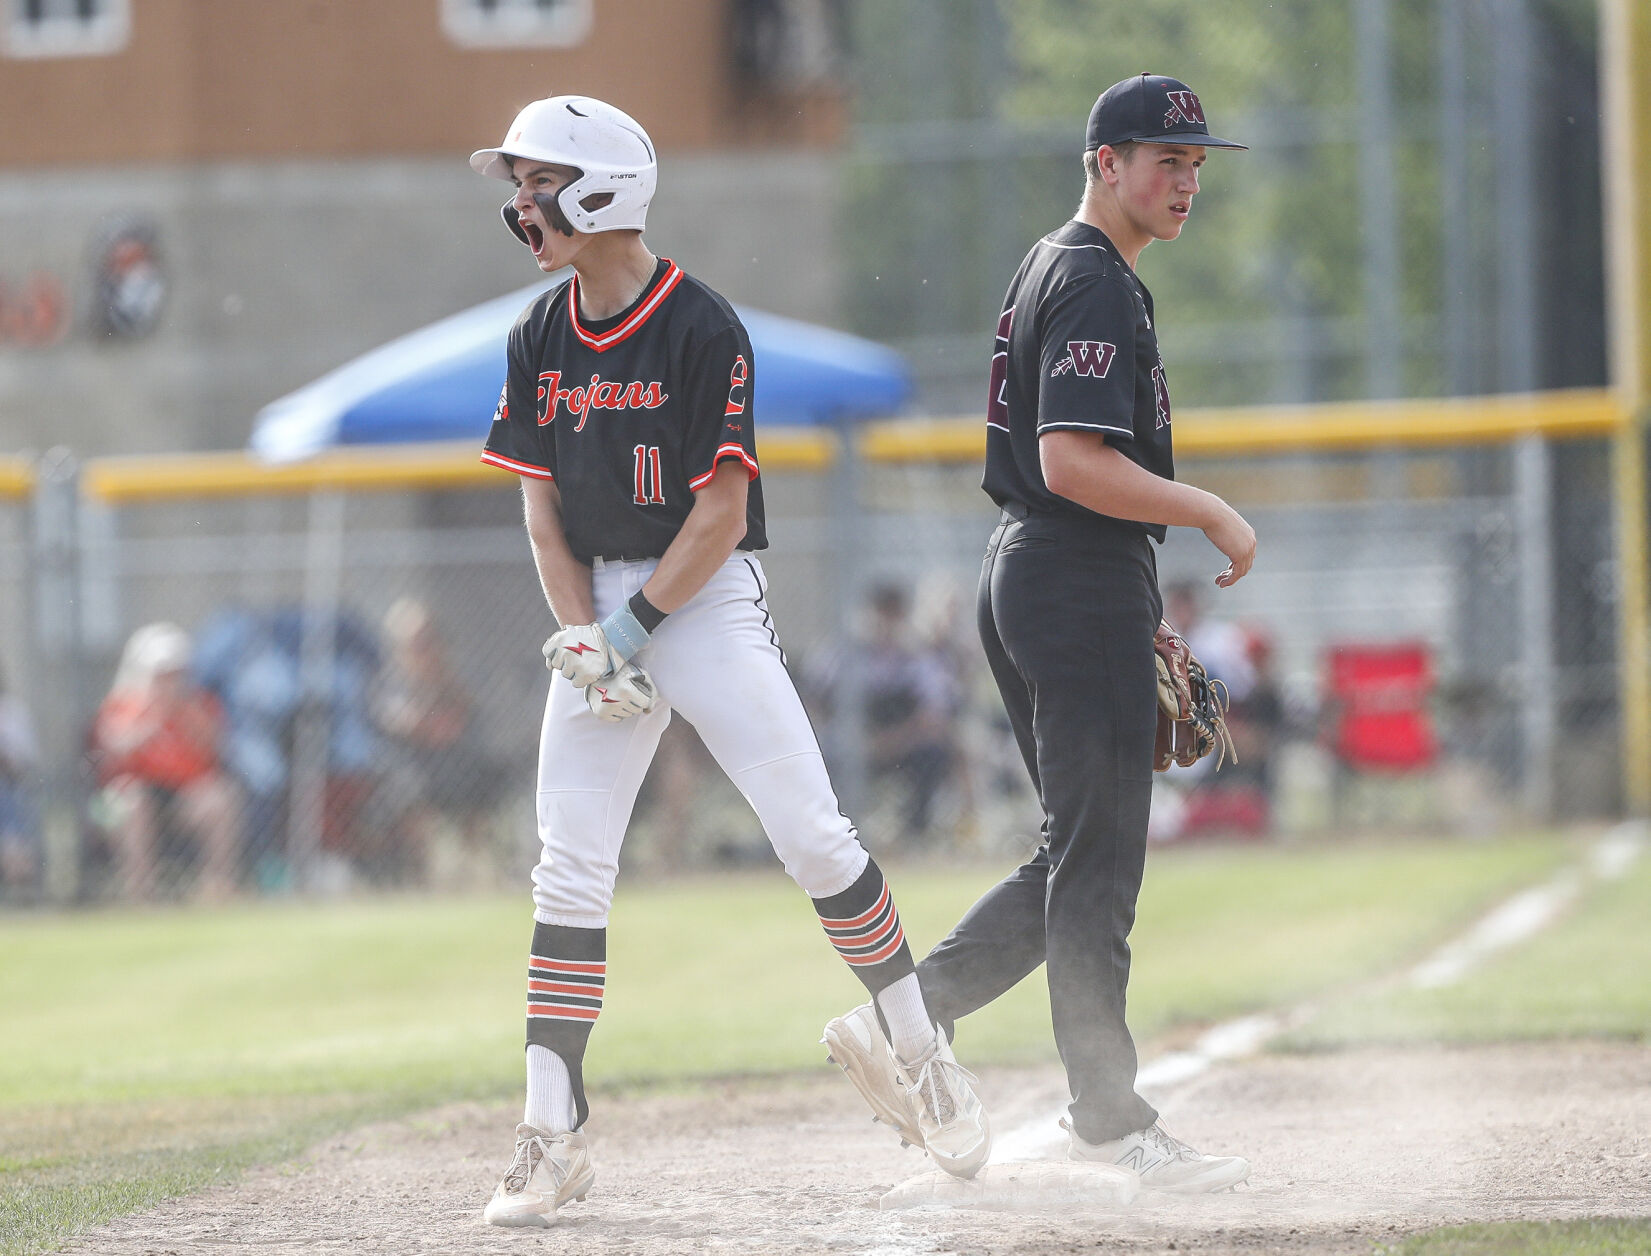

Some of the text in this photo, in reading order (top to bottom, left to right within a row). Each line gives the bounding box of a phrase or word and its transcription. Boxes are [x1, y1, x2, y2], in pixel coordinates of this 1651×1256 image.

[1166, 91, 1205, 124] W
[1067, 341, 1116, 379] W
[537, 370, 669, 432] Trojans
[633, 444, 666, 505] 11
